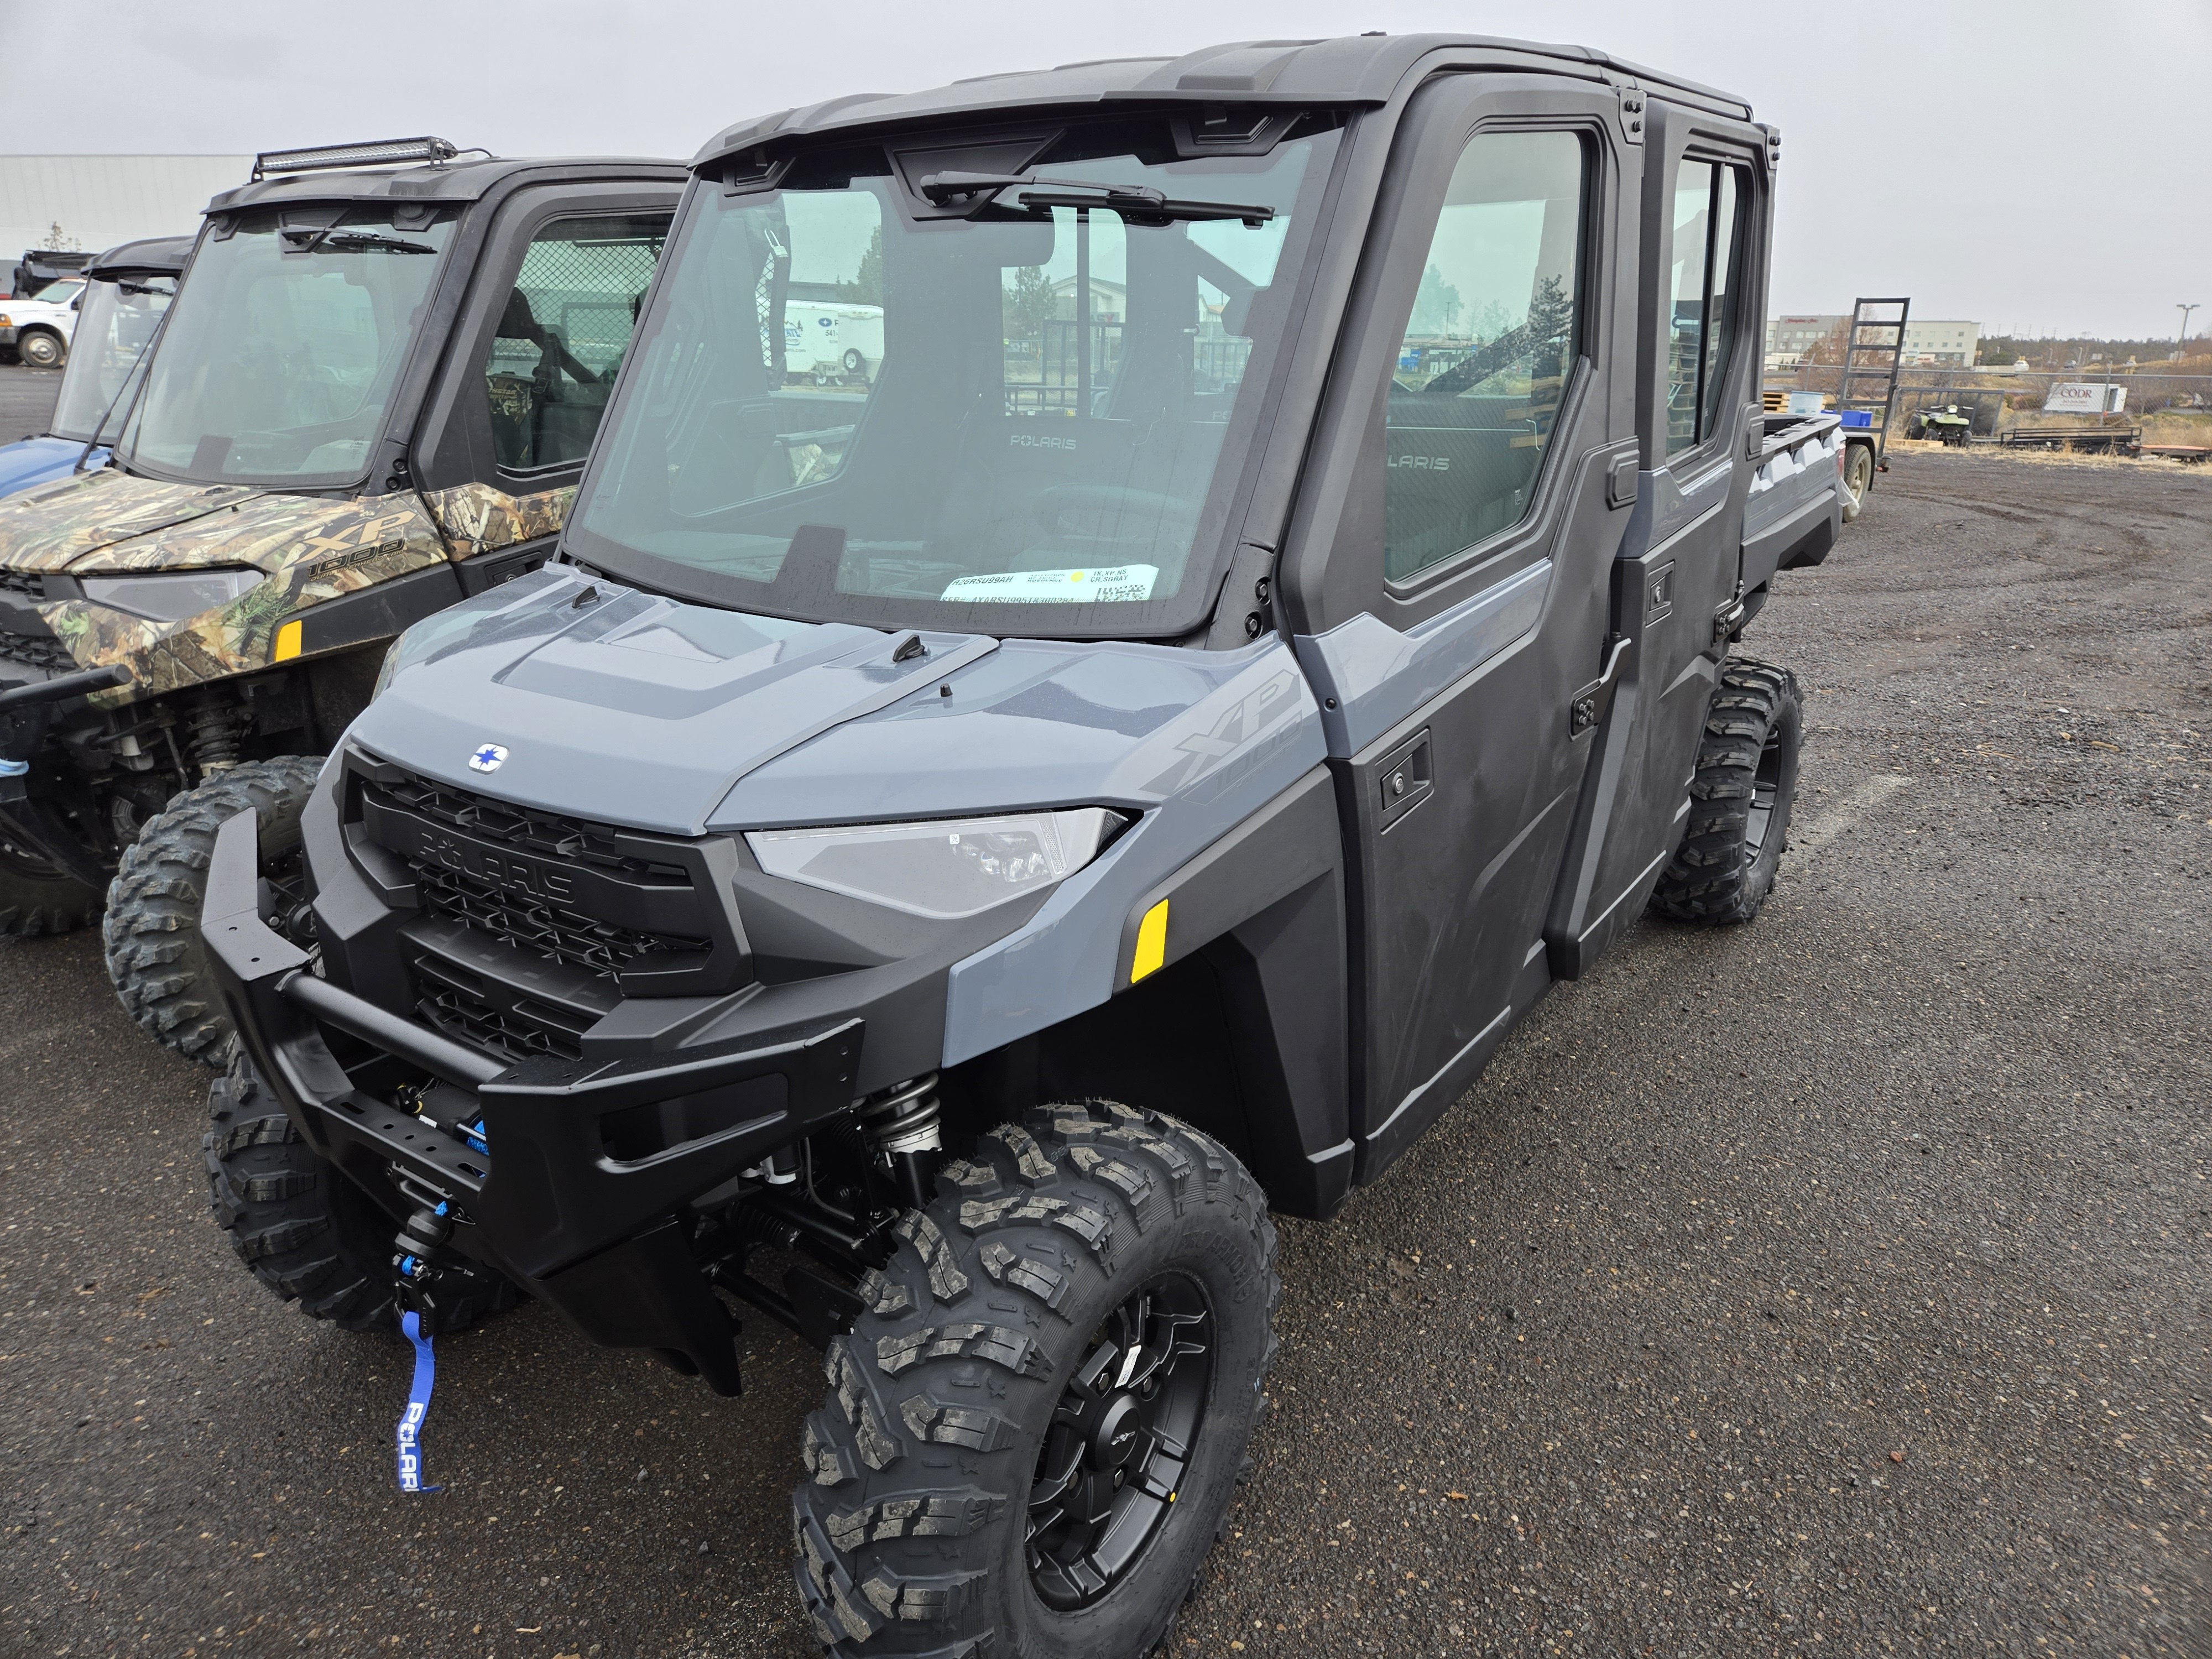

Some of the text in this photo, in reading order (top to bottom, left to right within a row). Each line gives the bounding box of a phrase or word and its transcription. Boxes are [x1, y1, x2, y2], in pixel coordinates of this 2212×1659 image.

[1010, 435, 1077, 450] POLARIS
[1387, 455, 1450, 470] LARIS
[292, 509, 416, 565] XP
[308, 538, 405, 578] 1000
[952, 576, 1014, 586] R26RSU99AH
[1156, 669, 1300, 795] XP
[419, 831, 576, 904] POLARIS
